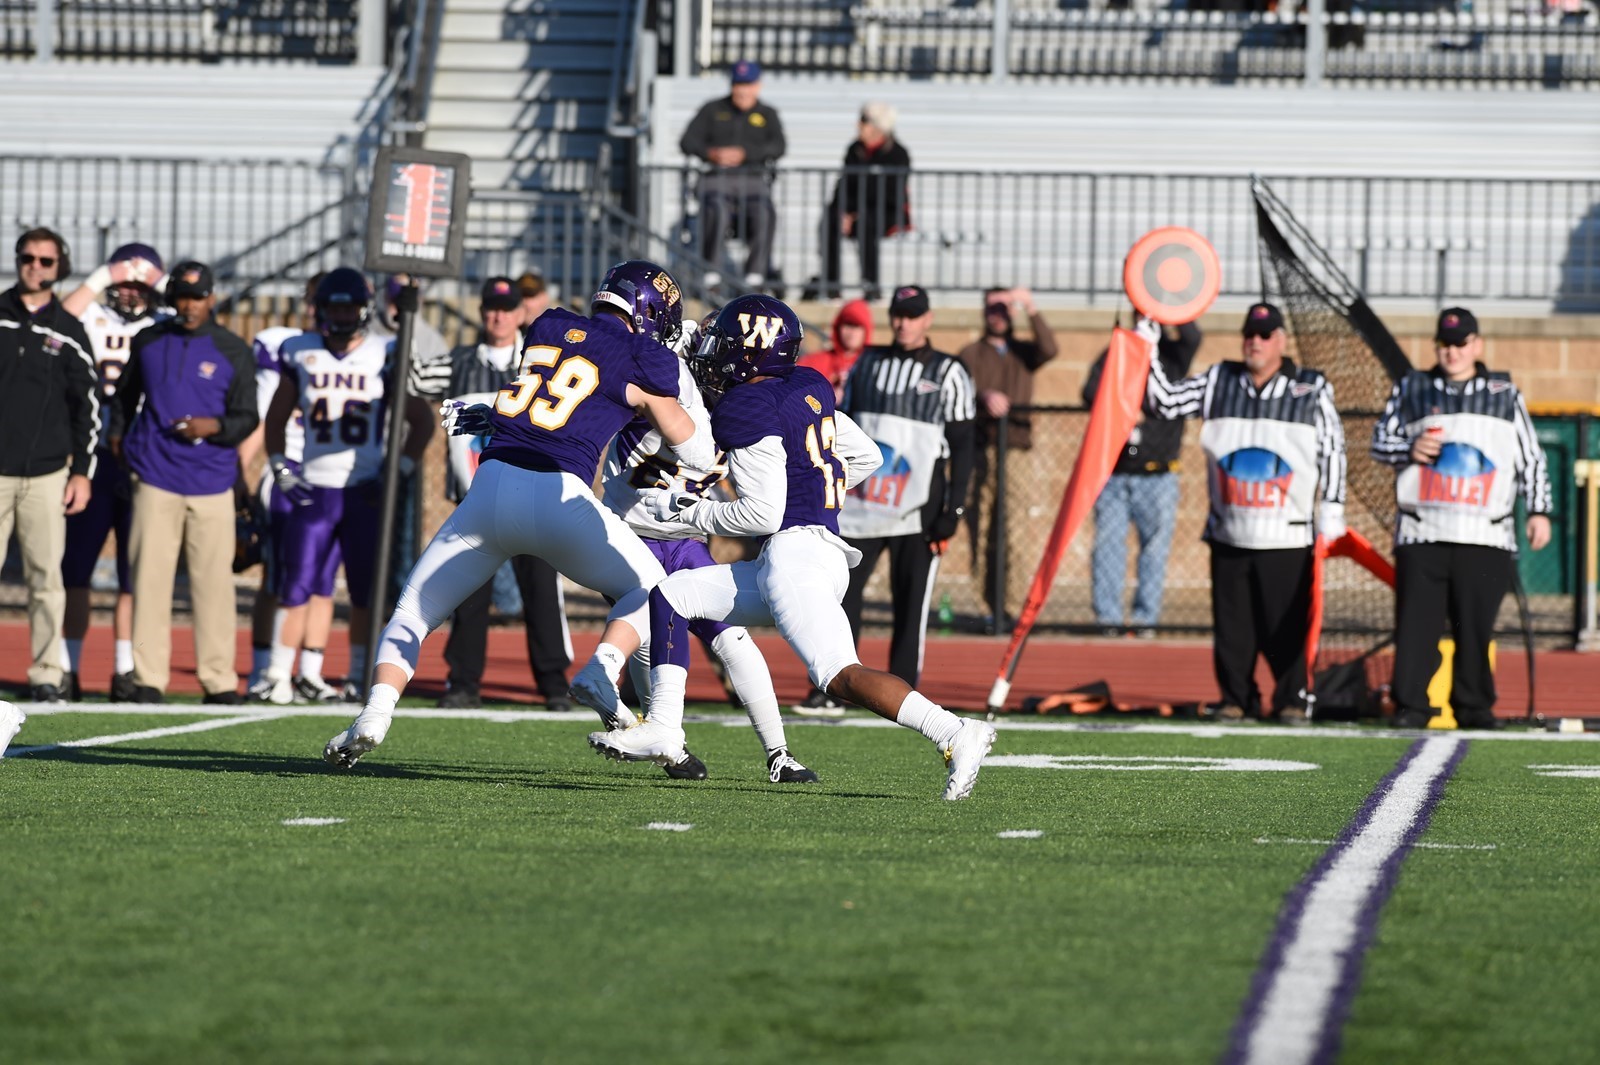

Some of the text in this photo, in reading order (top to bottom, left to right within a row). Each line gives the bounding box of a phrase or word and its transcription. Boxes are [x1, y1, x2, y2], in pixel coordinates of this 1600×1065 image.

[393, 163, 436, 244] 1
[737, 313, 784, 349] W
[310, 373, 366, 391] UNI
[495, 345, 600, 431] 59
[310, 397, 371, 446] 46
[805, 416, 848, 509] 13
[1418, 463, 1496, 507] VALLEY
